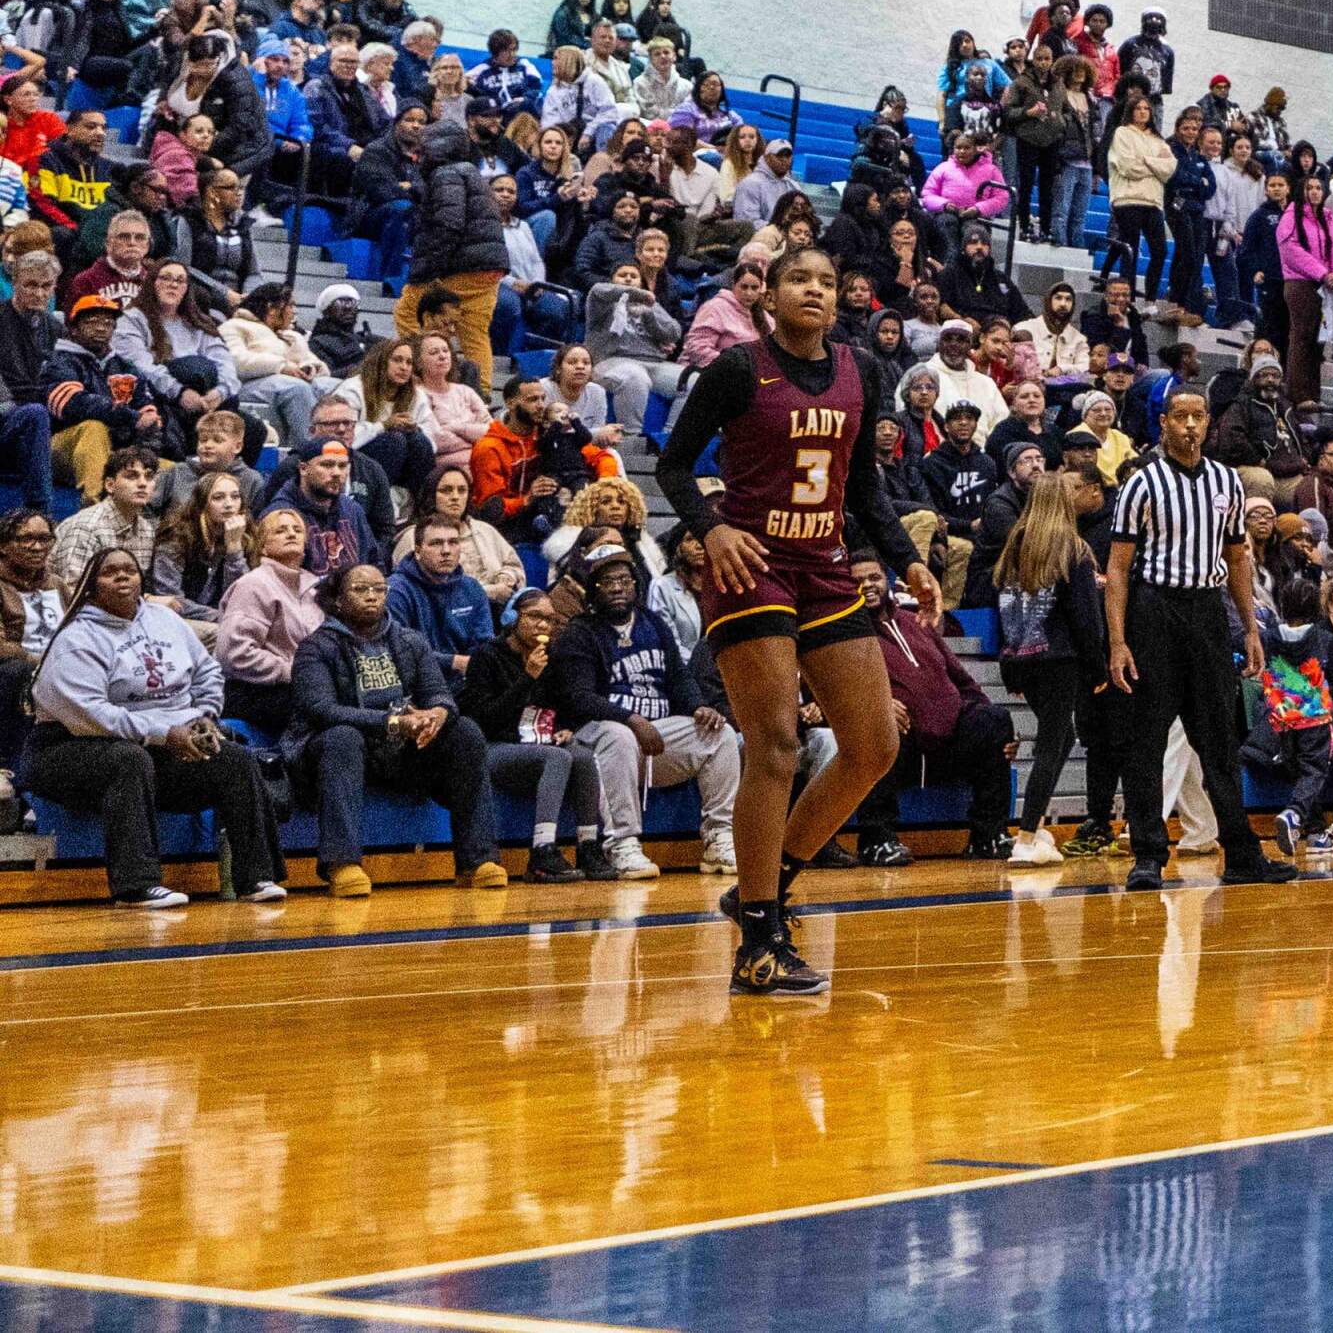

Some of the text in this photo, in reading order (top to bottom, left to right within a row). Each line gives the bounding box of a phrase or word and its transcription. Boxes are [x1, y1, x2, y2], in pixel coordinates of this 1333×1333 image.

[789, 408, 847, 439] LADY
[791, 449, 832, 505] 3
[766, 510, 834, 539] GIANTS
